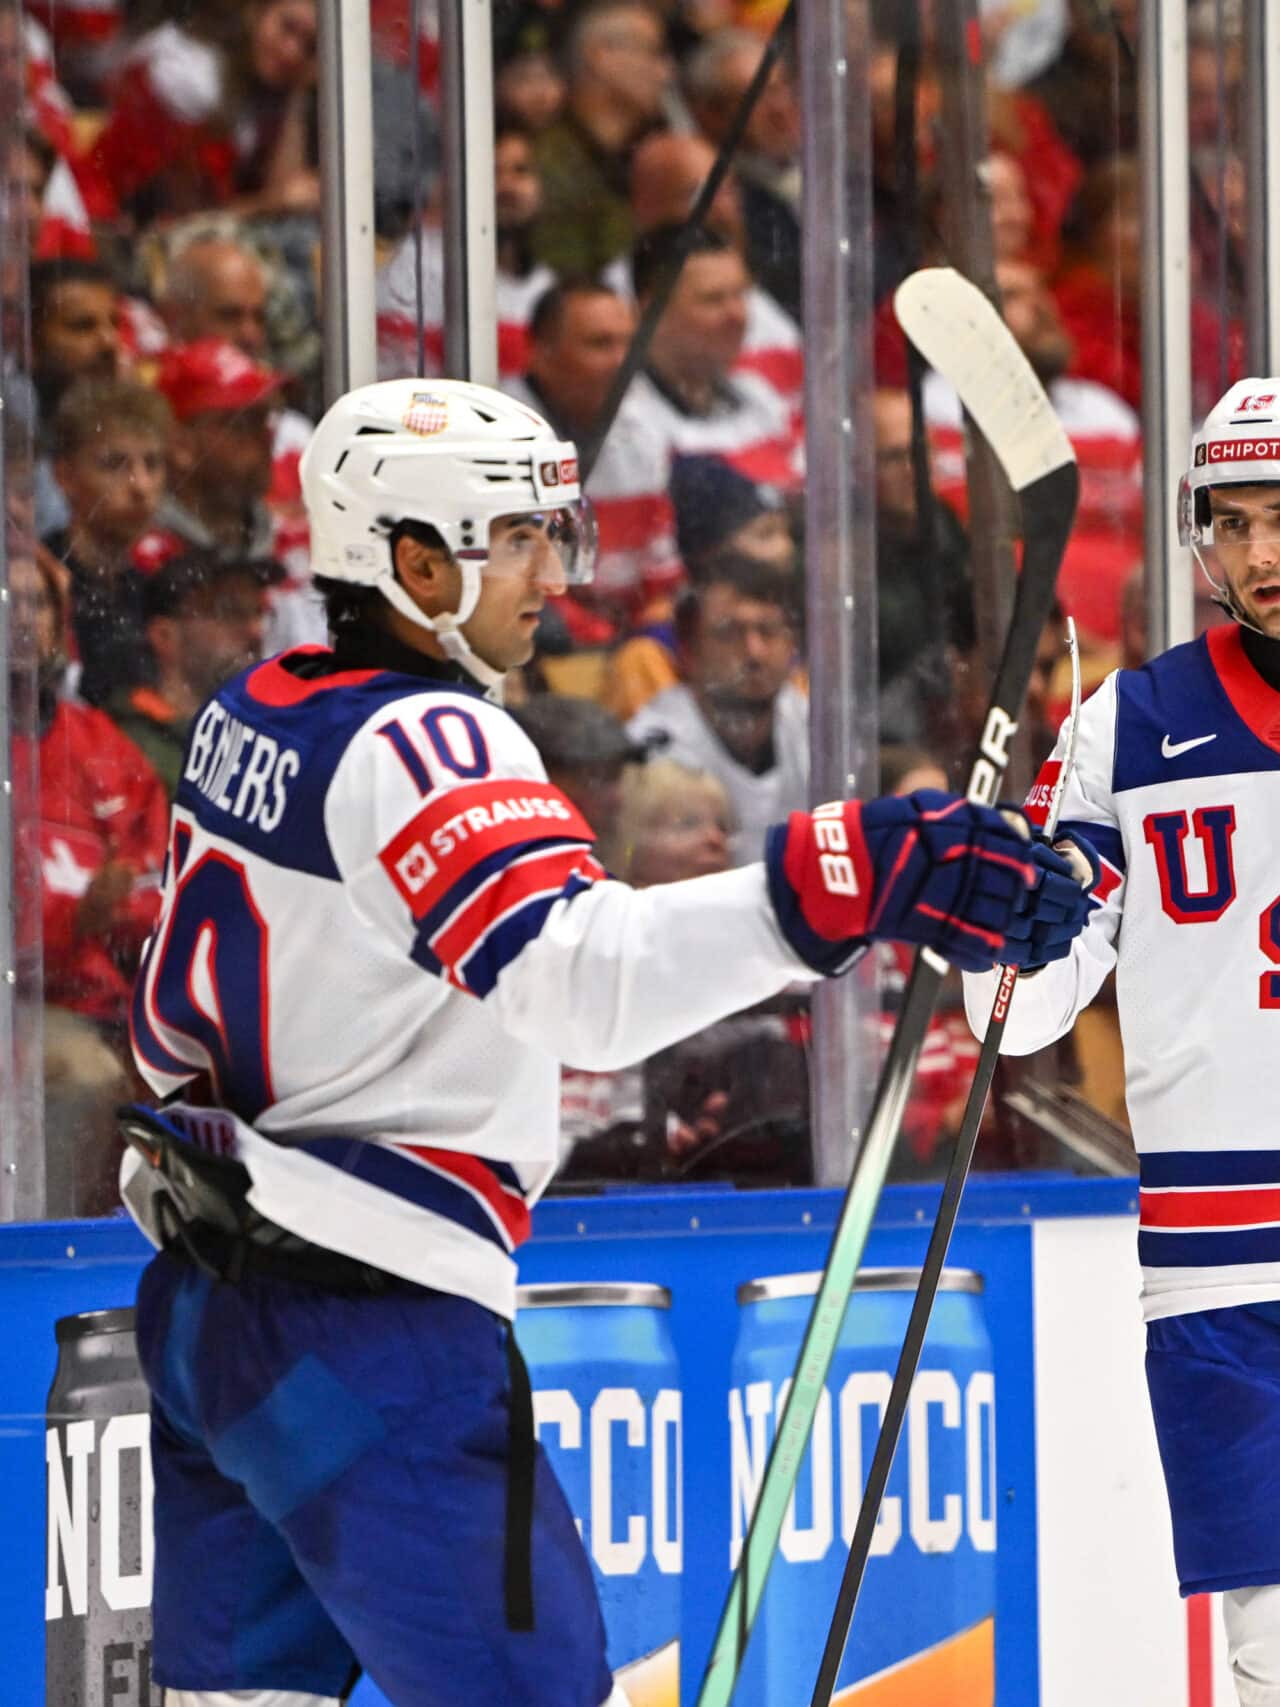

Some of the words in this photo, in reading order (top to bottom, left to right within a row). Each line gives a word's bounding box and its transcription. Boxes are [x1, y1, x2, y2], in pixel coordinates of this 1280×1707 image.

[374, 705, 491, 798] 10
[430, 797, 571, 857] STRAUSS
[994, 965, 1016, 1019] CCM
[729, 1370, 996, 1570] NOCCO
